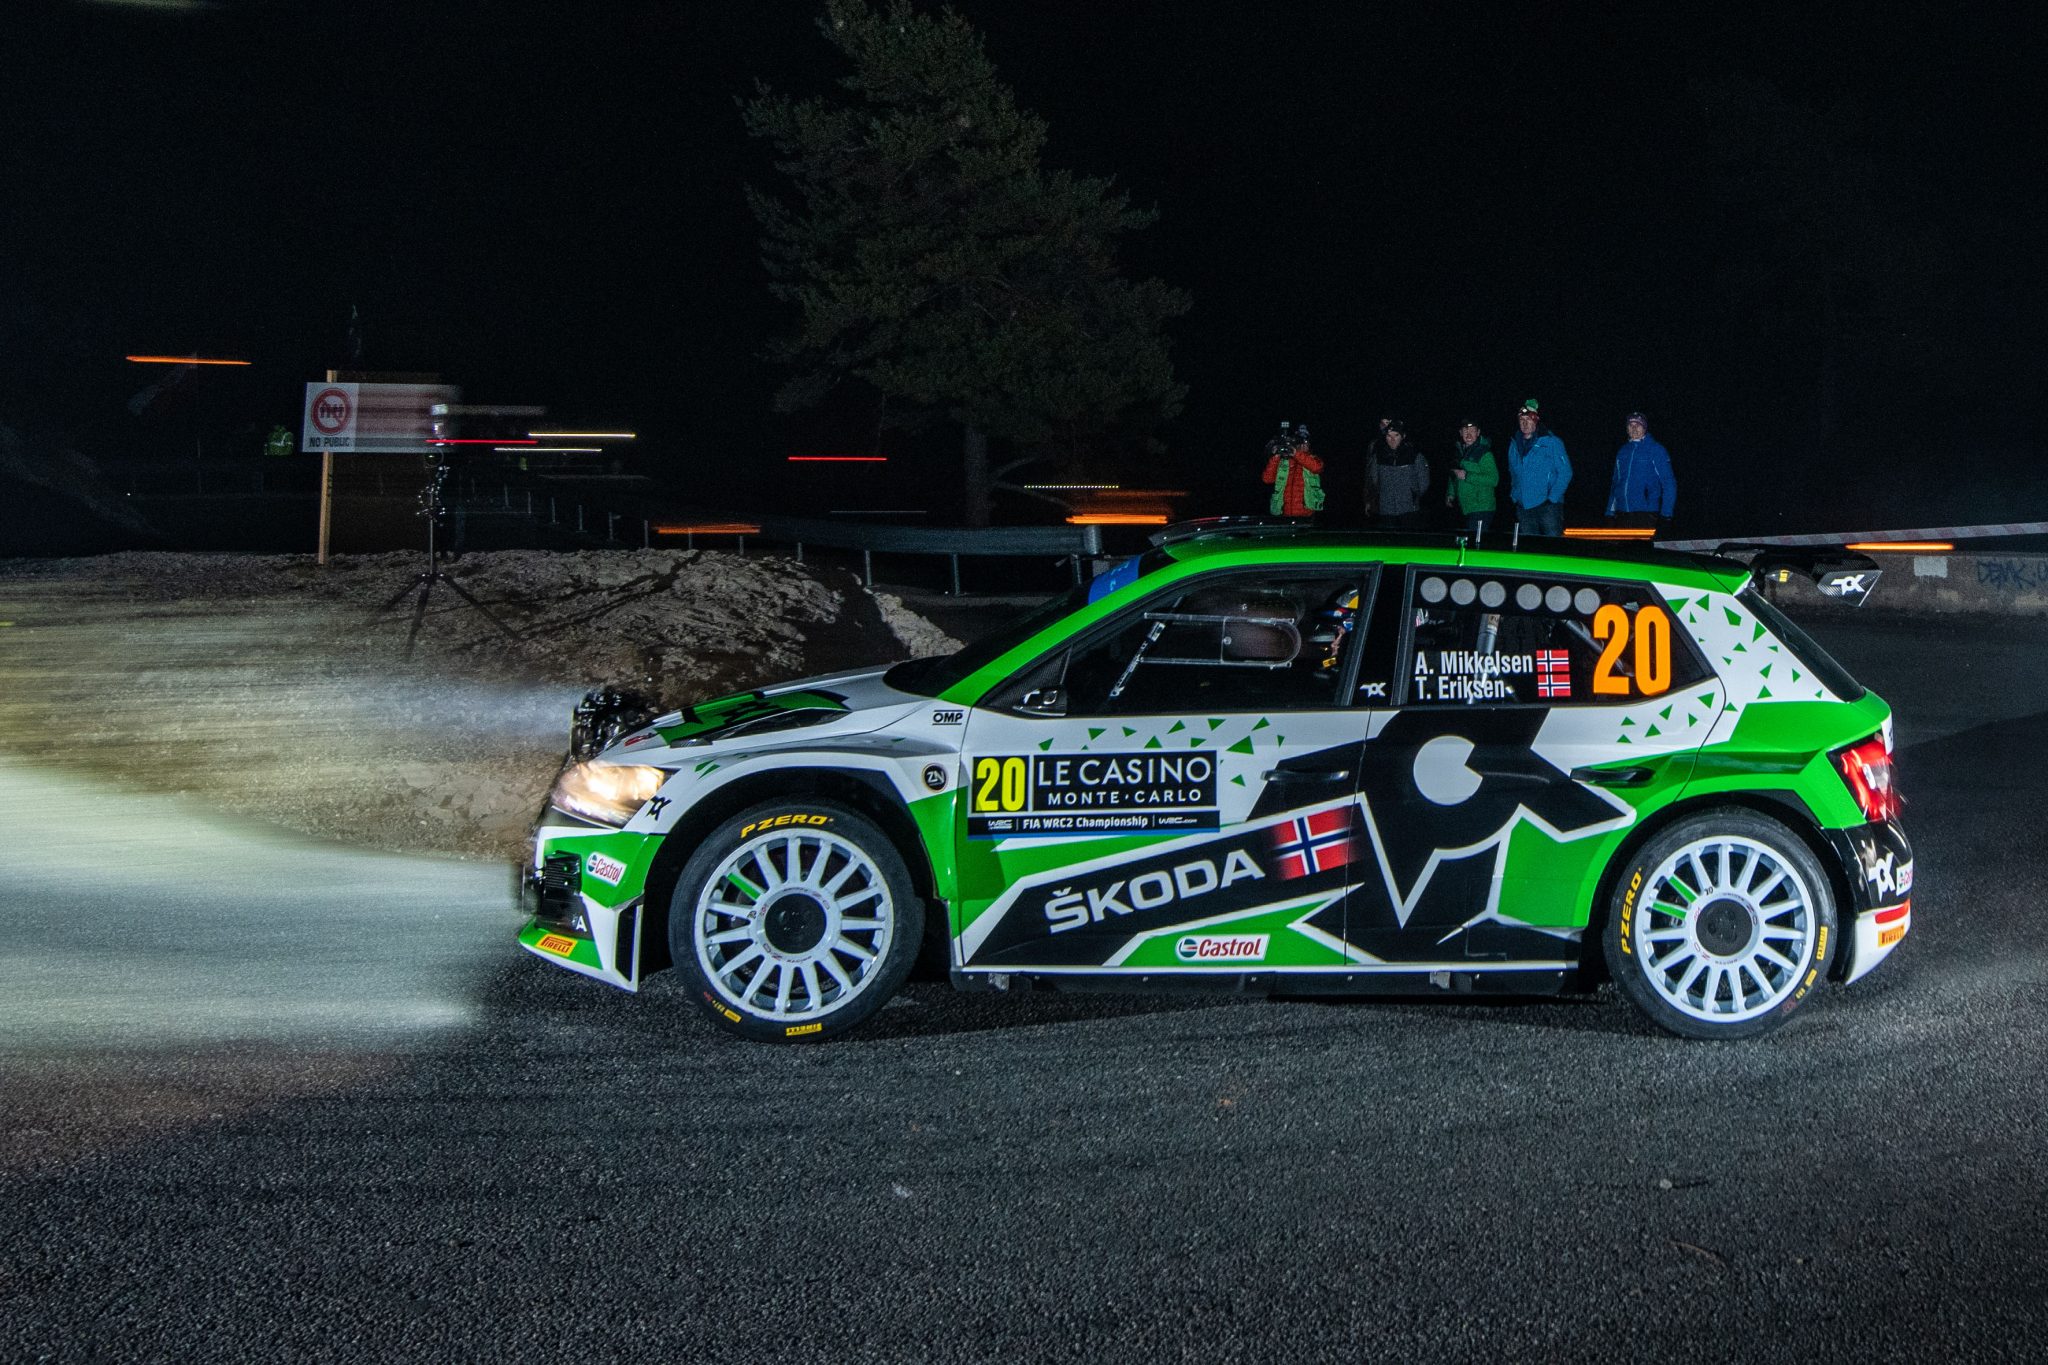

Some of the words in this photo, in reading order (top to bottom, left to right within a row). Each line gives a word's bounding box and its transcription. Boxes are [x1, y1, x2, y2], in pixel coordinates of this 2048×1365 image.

[309, 437, 320, 447] NO
[323, 437, 350, 447] PUBLIC
[1593, 604, 1671, 696] 20
[1415, 651, 1434, 675] A.
[1441, 650, 1533, 675] Mikkelsen
[1415, 676, 1431, 700] T.
[1438, 676, 1505, 700] Eriksen
[933, 712, 963, 723] OMP
[926, 770, 945, 784] ZN
[1038, 760, 1070, 786] LE
[1079, 757, 1211, 785] CASINO
[976, 757, 1025, 812] 20
[1023, 818, 1040, 830] FIA
[1043, 818, 1073, 829] WRC2
[1076, 815, 1148, 829] Championship
[595, 858, 623, 882] Castrol
[1044, 848, 1266, 934] ŠKODA
[540, 935, 574, 954] PIRELLI
[1881, 924, 1905, 945] PIRELLI
[1199, 938, 1262, 957] Castrol
